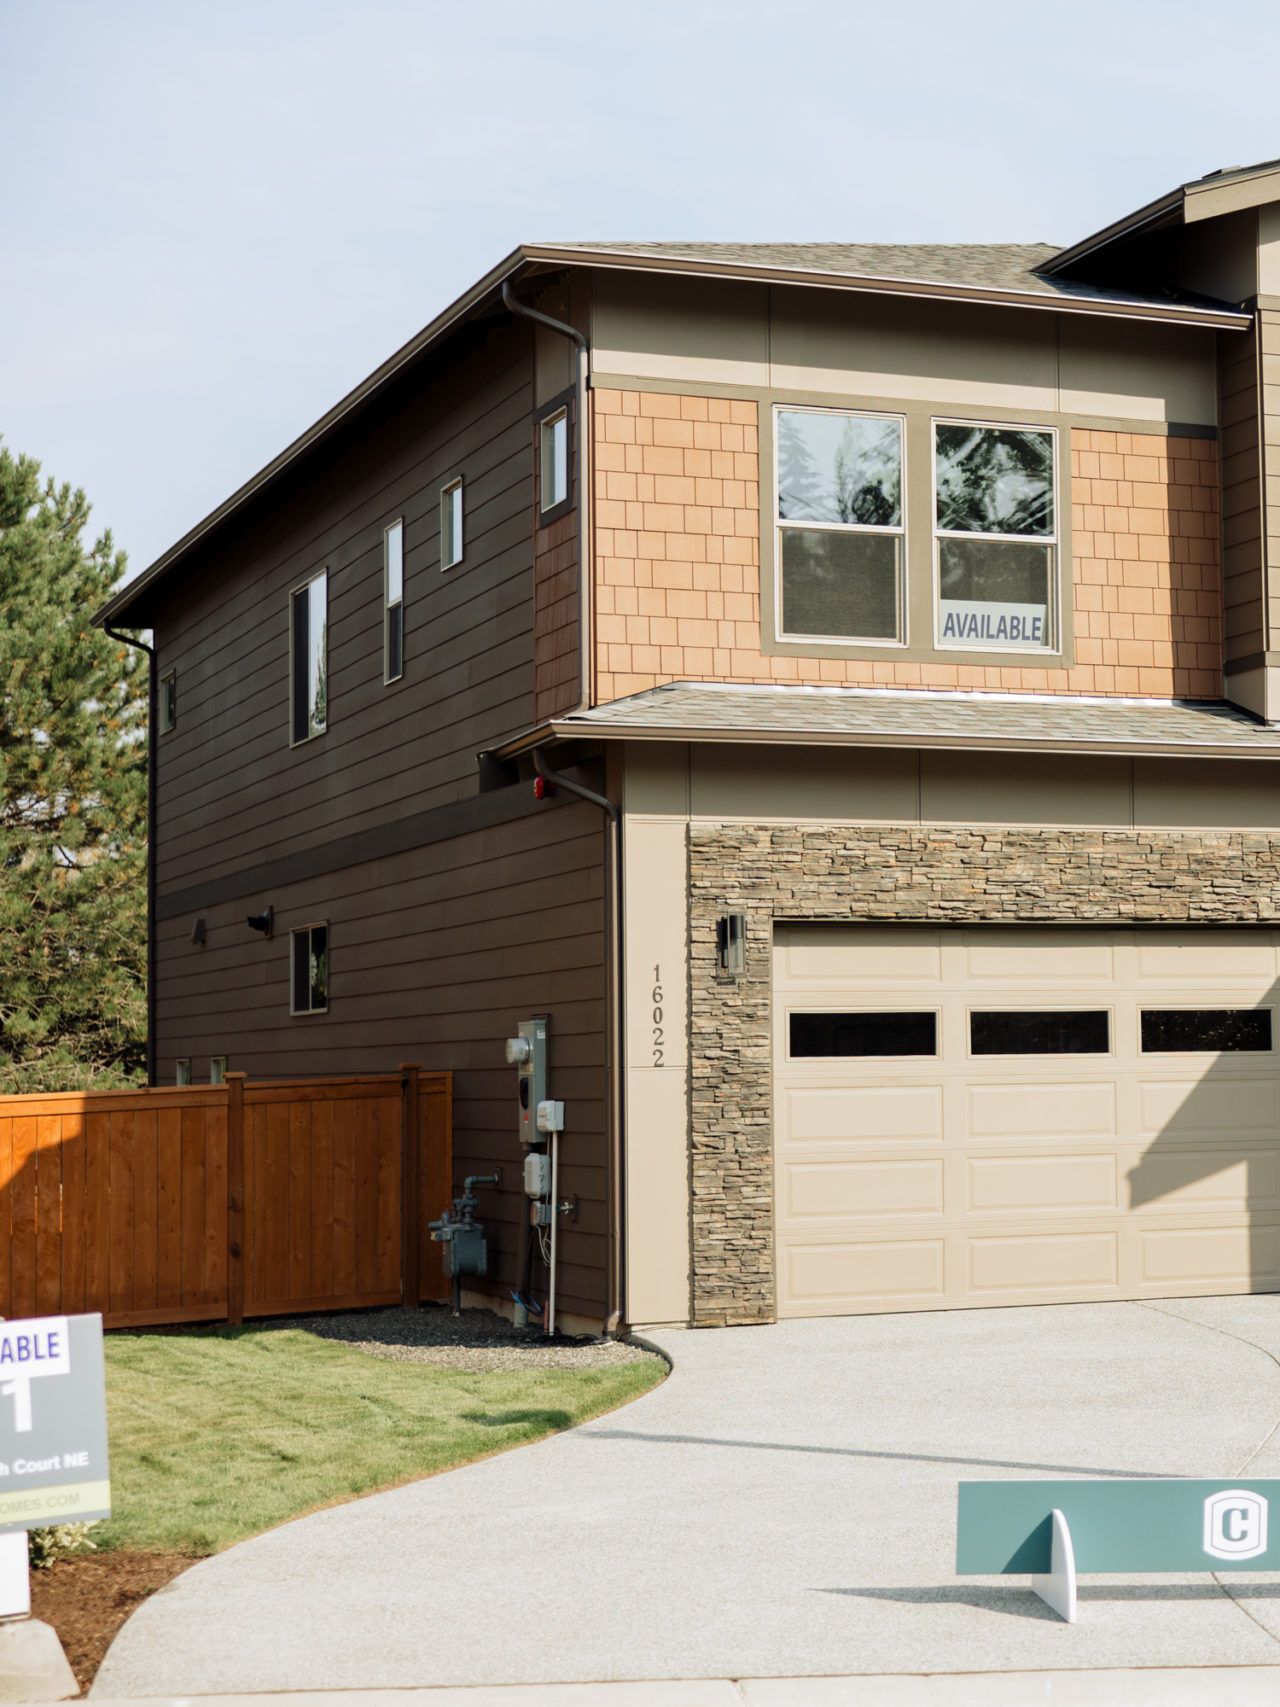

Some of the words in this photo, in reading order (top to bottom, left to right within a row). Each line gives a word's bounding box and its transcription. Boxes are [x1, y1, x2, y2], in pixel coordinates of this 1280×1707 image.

[943, 612, 1042, 642] AVAILABLE
[652, 963, 665, 1067] 16022
[0, 1331, 61, 1365] ABLE
[13, 1455, 61, 1475] Court
[63, 1451, 90, 1469] NE
